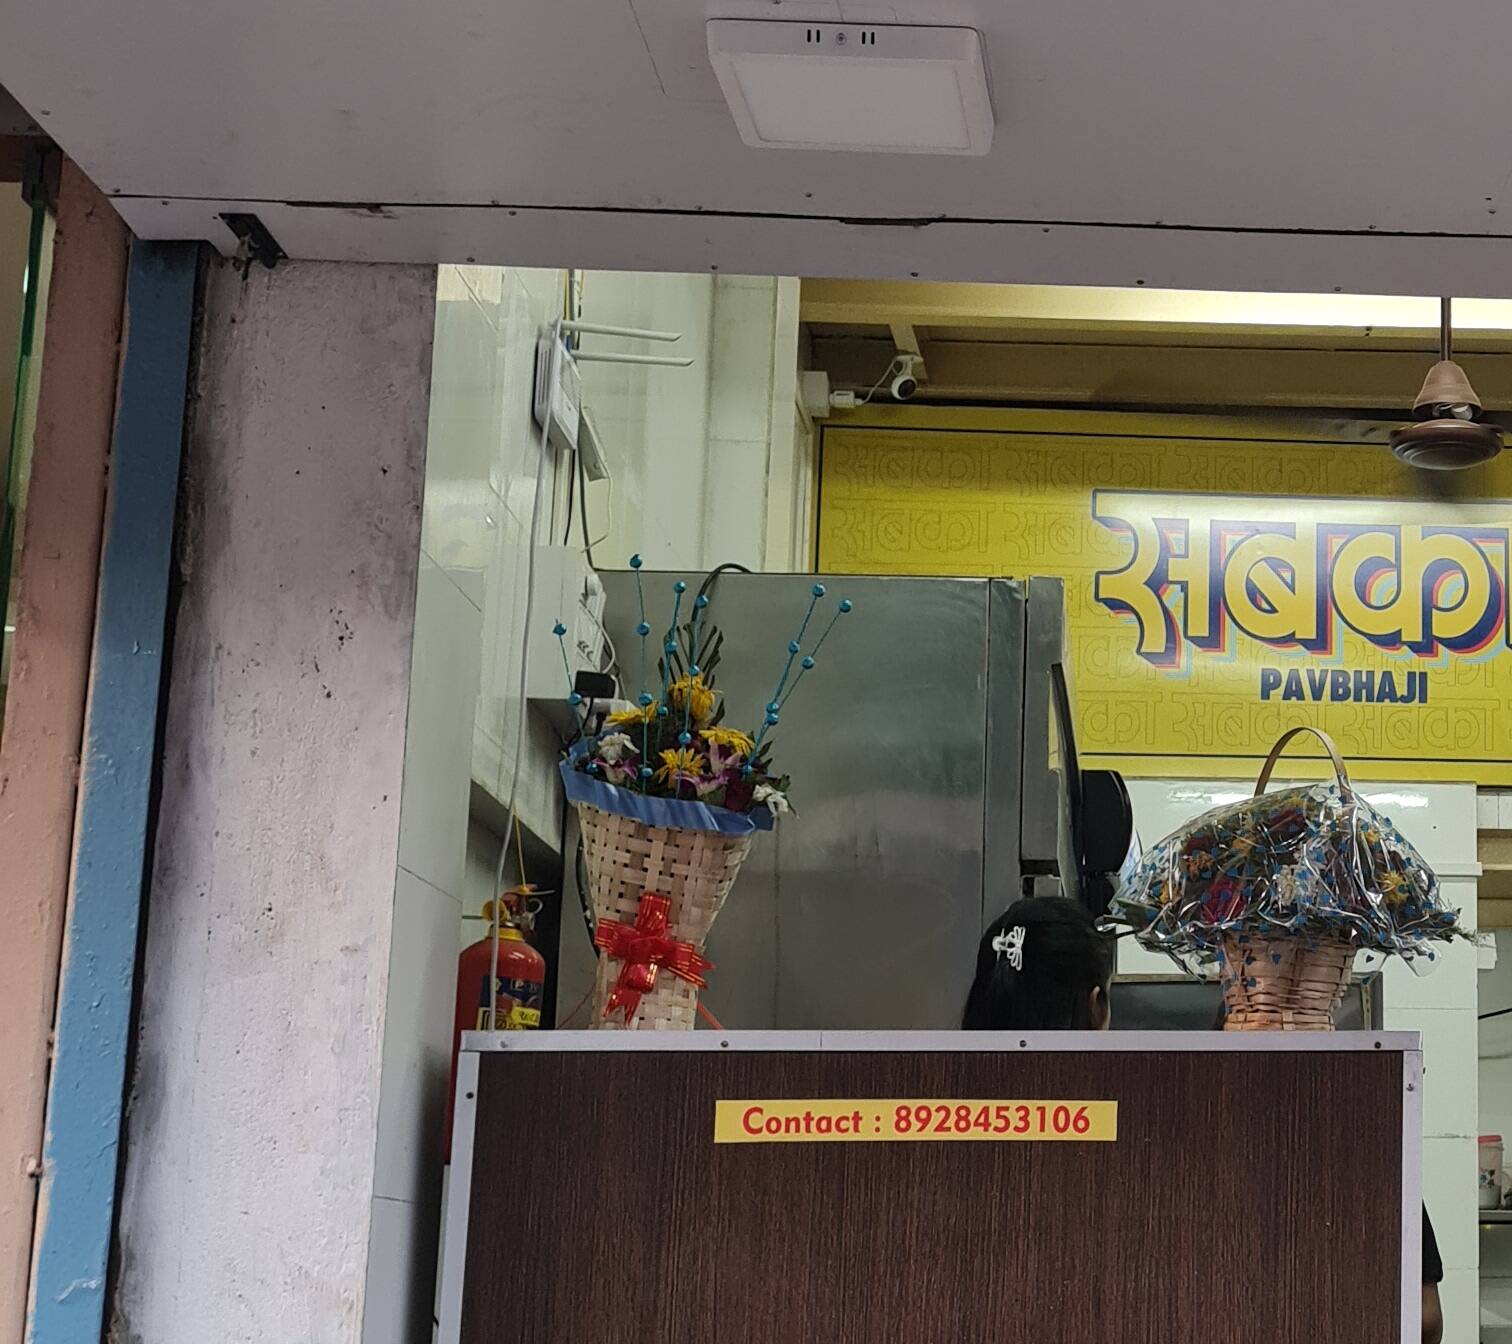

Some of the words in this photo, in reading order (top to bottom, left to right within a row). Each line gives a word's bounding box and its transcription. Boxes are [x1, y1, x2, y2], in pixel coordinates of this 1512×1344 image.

[1259, 668, 1429, 705] PAVBHAJI
[742, 1106, 863, 1136] Contact
[893, 1104, 1091, 1135] 8928453106
